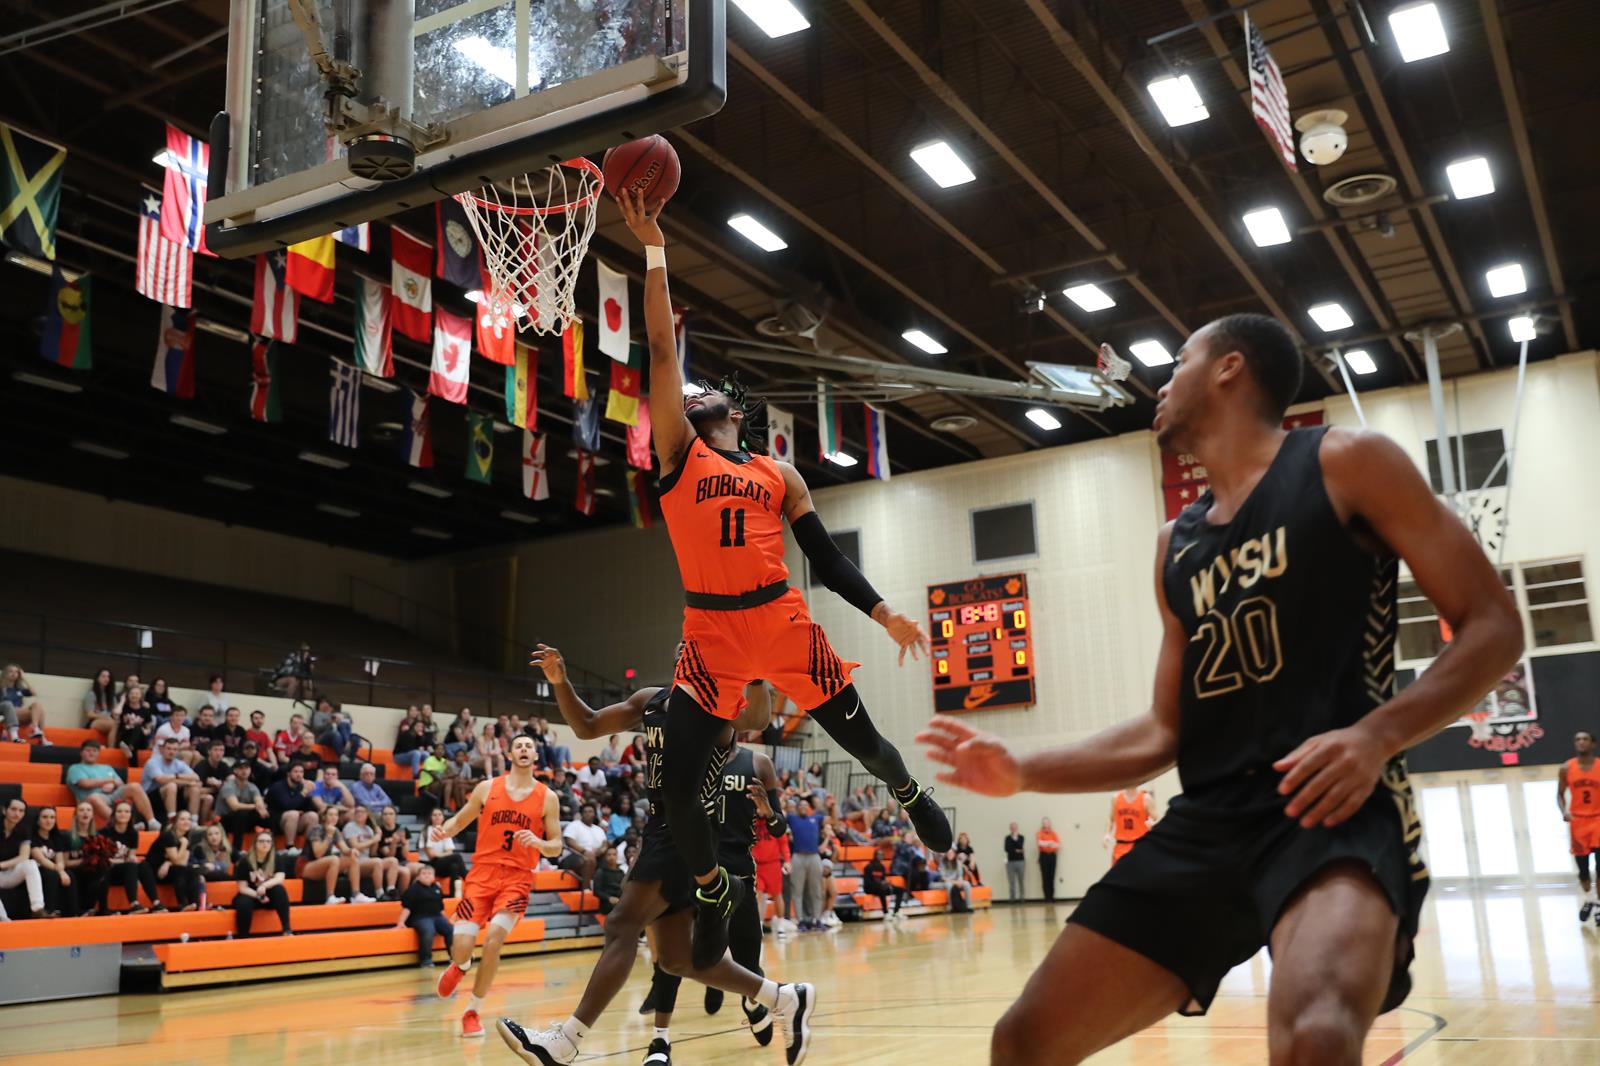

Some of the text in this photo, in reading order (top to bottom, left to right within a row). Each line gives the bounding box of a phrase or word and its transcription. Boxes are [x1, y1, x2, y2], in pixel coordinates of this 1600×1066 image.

[696, 474, 771, 512] BOBCATS
[720, 507, 746, 548] 11
[942, 620, 954, 638] 0
[1014, 610, 1026, 629] 0
[1015, 650, 1026, 665] 0
[1190, 596, 1283, 699] 20
[938, 659, 948, 674] 0
[491, 809, 531, 830] BOBCATS
[502, 830, 515, 851] 3
